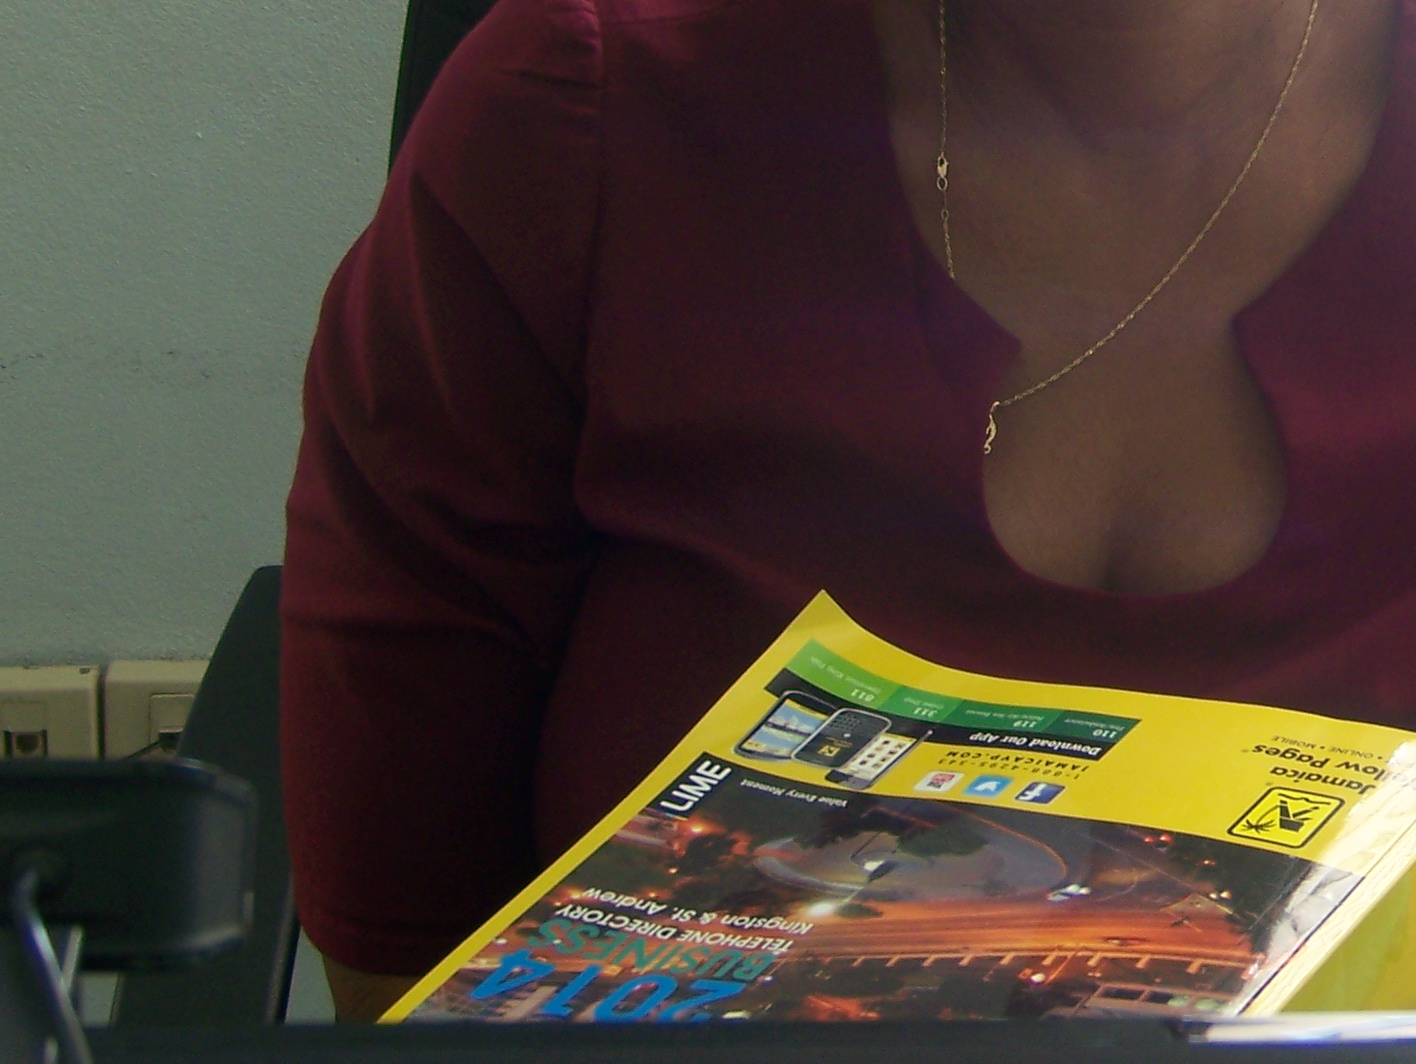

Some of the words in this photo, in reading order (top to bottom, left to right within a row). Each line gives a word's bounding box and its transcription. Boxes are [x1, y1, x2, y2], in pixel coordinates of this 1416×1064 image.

[969, 732, 1000, 743] App
[1000, 734, 1027, 746] Our
[1092, 728, 1118, 739] 110
[1271, 735, 1317, 750] MOBILE
[1028, 737, 1103, 756] Download
[1329, 745, 1374, 760] ONLINE
[1251, 744, 1330, 769] Pages
[660, 759, 732, 812] LIME
[740, 778, 786, 796] Moment
[1270, 765, 1377, 795] Jamaica
[786, 788, 818, 803] Every
[583, 887, 669, 916] Andrew
[554, 904, 678, 940] DIRECTORY
[672, 906, 698, 924] St.
[700, 910, 720, 925] &
[721, 912, 814, 935] Kingston
[526, 918, 779, 982] BUSINESS
[677, 928, 795, 955] TELEPHONE
[469, 948, 748, 1024] 2014
